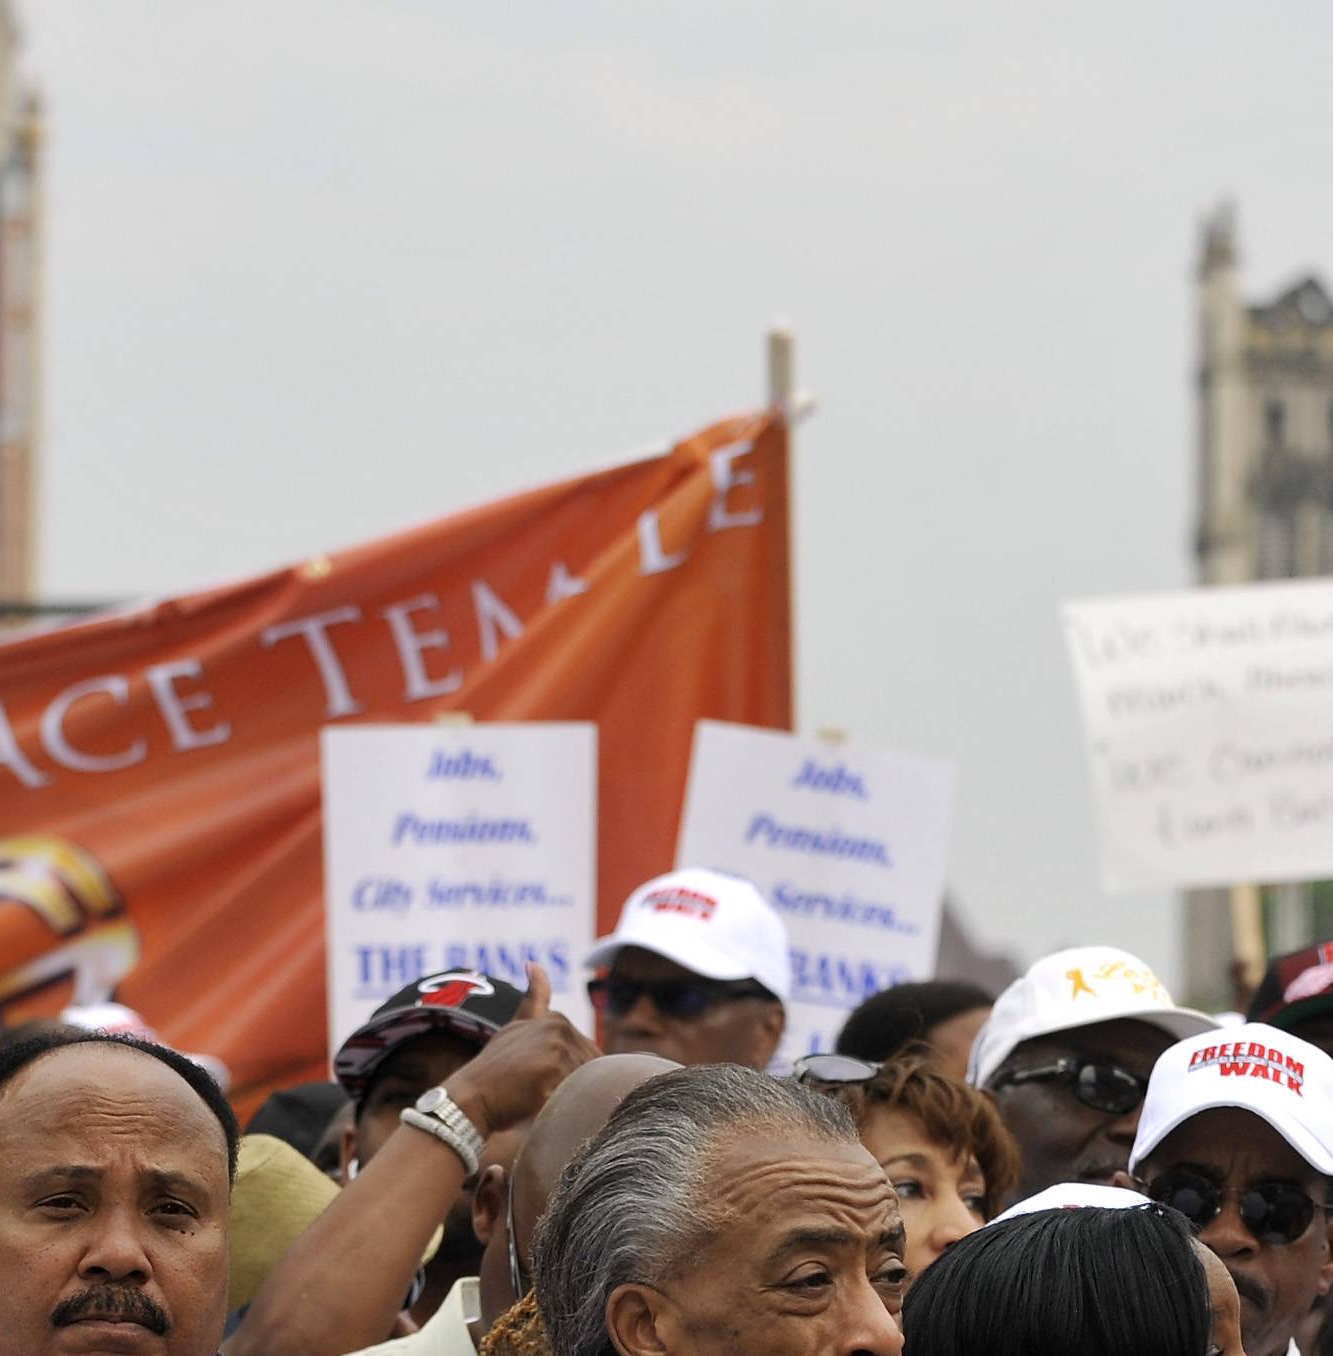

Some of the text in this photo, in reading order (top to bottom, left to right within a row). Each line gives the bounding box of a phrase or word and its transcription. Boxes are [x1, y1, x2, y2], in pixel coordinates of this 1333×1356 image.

[265, 438, 764, 719] TEMLE
[352, 878, 414, 914] City
[355, 944, 426, 984] THE
[1190, 1042, 1304, 1080] FREEDOM
[1219, 1062, 1304, 1098] WALK
